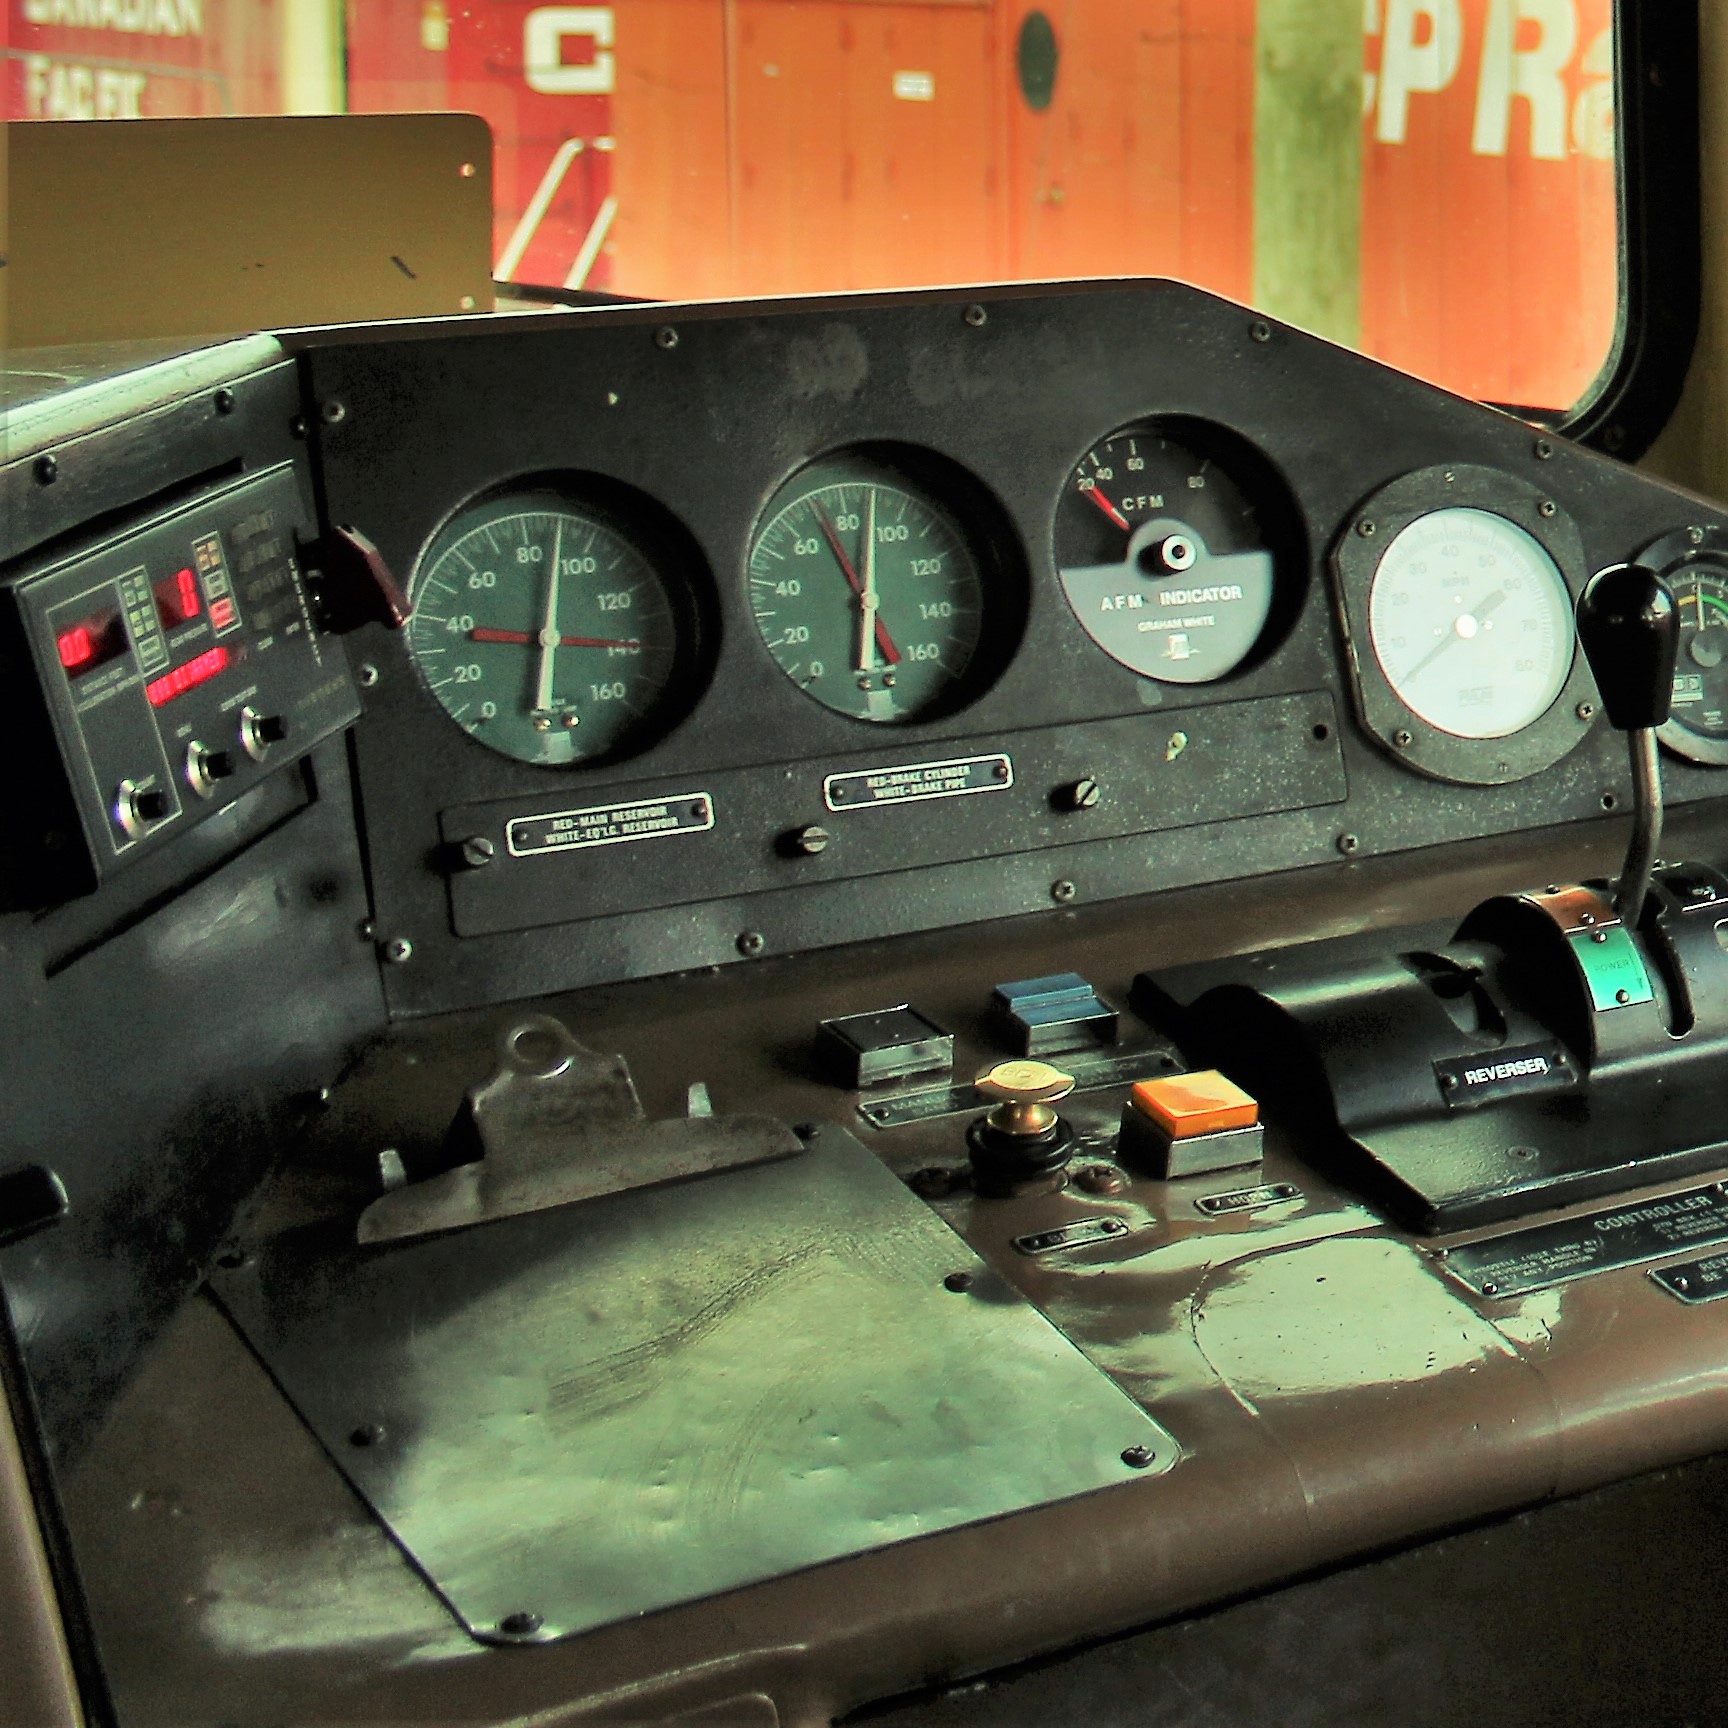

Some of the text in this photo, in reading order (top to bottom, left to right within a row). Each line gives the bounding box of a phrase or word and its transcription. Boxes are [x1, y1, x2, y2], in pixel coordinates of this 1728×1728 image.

[1077, 477, 1096, 491] 20
[836, 513, 861, 531] 80
[876, 524, 909, 543] 100
[515, 545, 543, 563] 80
[793, 538, 819, 555] 60
[561, 557, 596, 576] 100
[910, 558, 942, 576] 120
[468, 571, 496, 589] 60
[775, 579, 801, 597] 40
[597, 592, 632, 611] 120
[1160, 584, 1243, 606] INDICATOR
[918, 601, 952, 620] 140
[446, 615, 474, 633] 40
[1137, 615, 1215, 633] GRAHAM WHITE
[783, 626, 809, 644] 20
[906, 643, 940, 661] 160
[454, 664, 482, 683] 20
[809, 660, 825, 677] 0
[590, 682, 626, 701] 160
[611, 805, 668, 822] RESERVOIR
[622, 816, 679, 834] RESERVOIR
[1594, 959, 1630, 973] POWER
[1464, 1057, 1550, 1085] REVERSER
[1594, 1195, 1713, 1232] CONTROLLER
